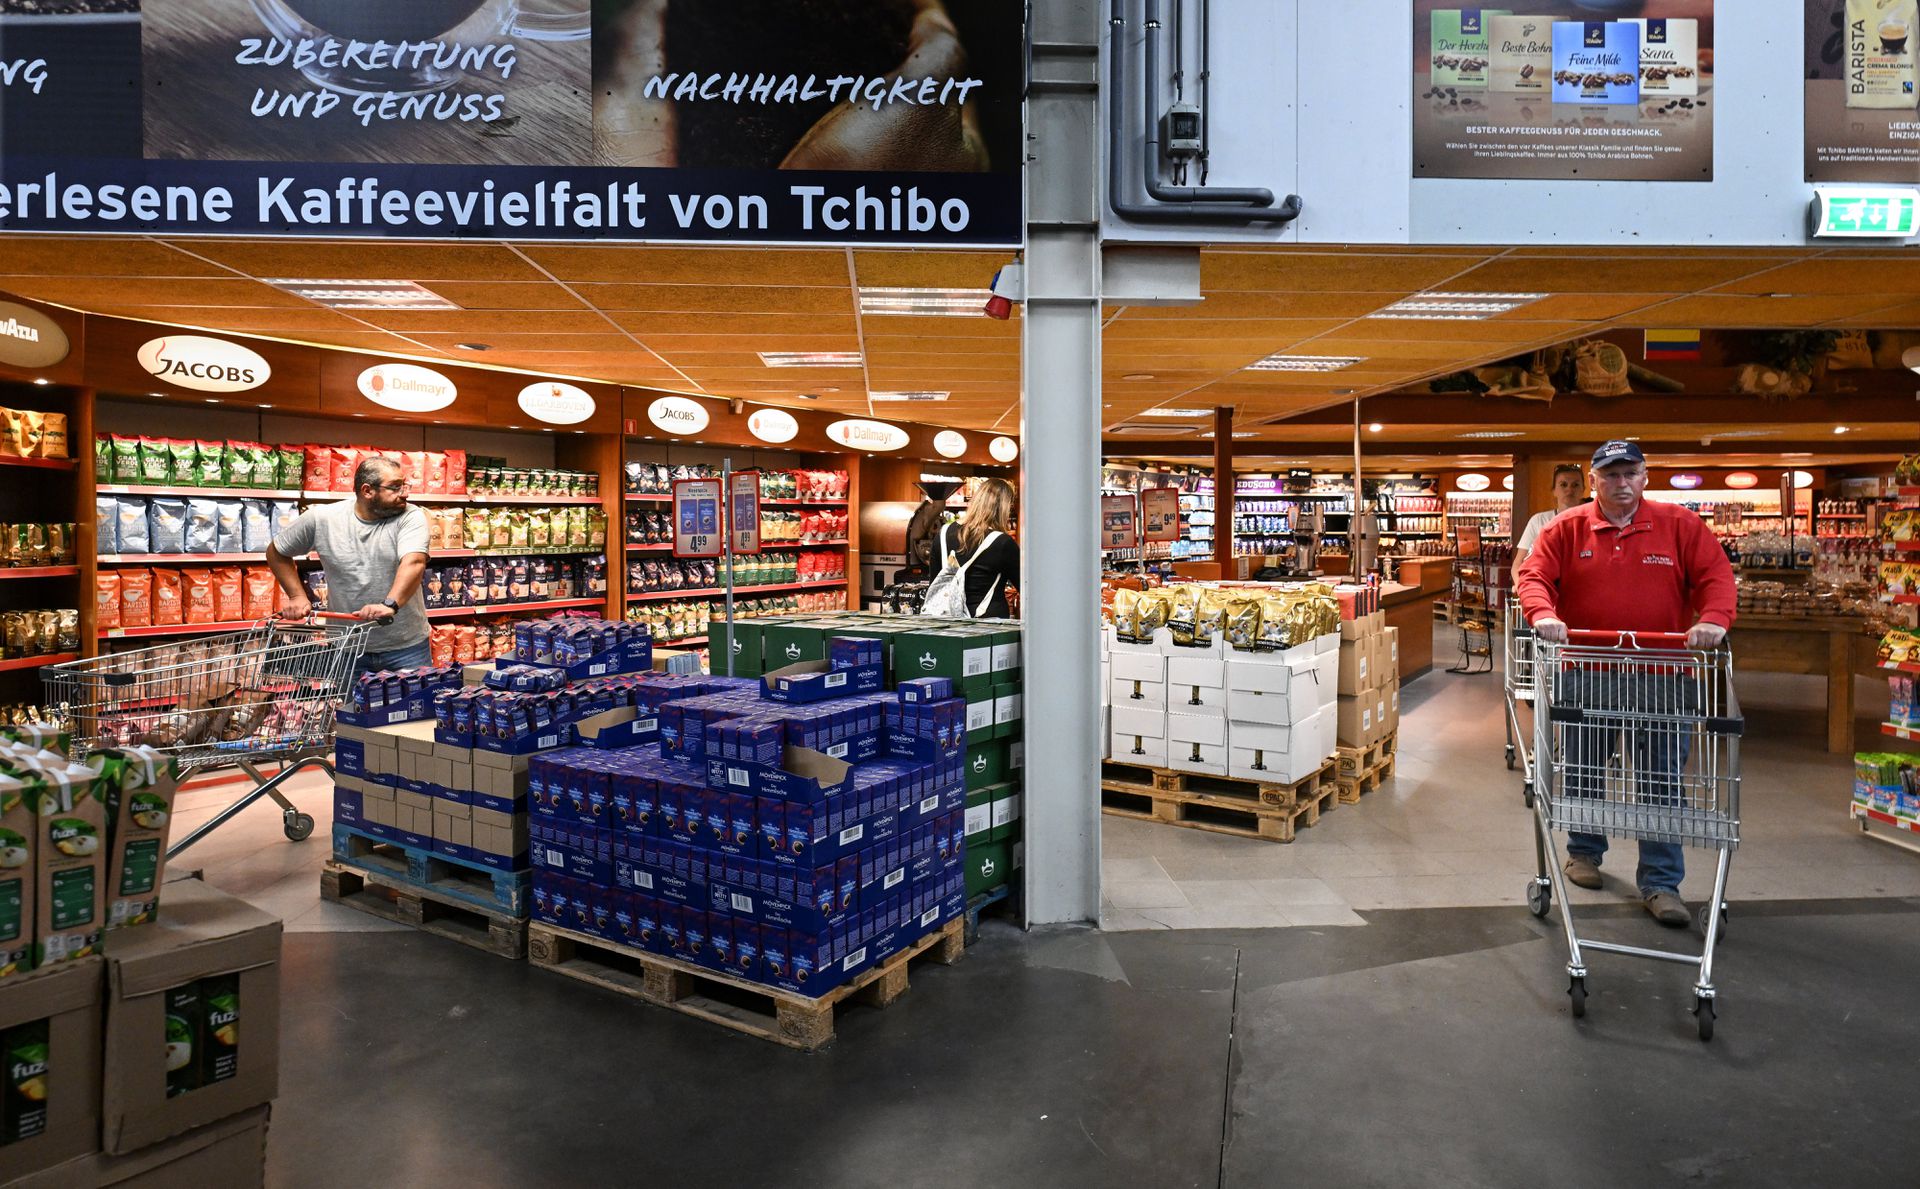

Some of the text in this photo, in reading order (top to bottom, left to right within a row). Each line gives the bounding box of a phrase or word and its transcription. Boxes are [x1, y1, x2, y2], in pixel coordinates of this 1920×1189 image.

[1438, 39, 1457, 50] Der
[1502, 41, 1525, 53] Beste
[234, 38, 517, 78] ZUBEREITUNG
[1569, 52, 1621, 66] Feine Milde
[1640, 47, 1675, 60] Sana
[1852, 19, 1865, 94] BARISTA
[643, 71, 983, 111] NACHHALTIGKEIT
[251, 88, 506, 126] UND GENUSS
[1466, 126, 1662, 136] BESTER KAFFEEGENUSS FÜR JEDEN GESCHMACK.
[258, 176, 646, 229] Kaffeevielfalt
[668, 193, 768, 229] von
[790, 184, 970, 232] Tchibo
[152, 359, 255, 384] JACOBS
[392, 377, 447, 397] Dallmayr
[659, 408, 695, 421] JACOBS
[854, 426, 893, 444] Dallmayr
[1236, 480, 1276, 488] EDUSCHO
[690, 535, 707, 552] 4.99
[131, 803, 154, 811] fuze
[52, 829, 78, 840] fuze
[209, 1011, 239, 1026] fuz
[12, 1062, 48, 1079] fuz
